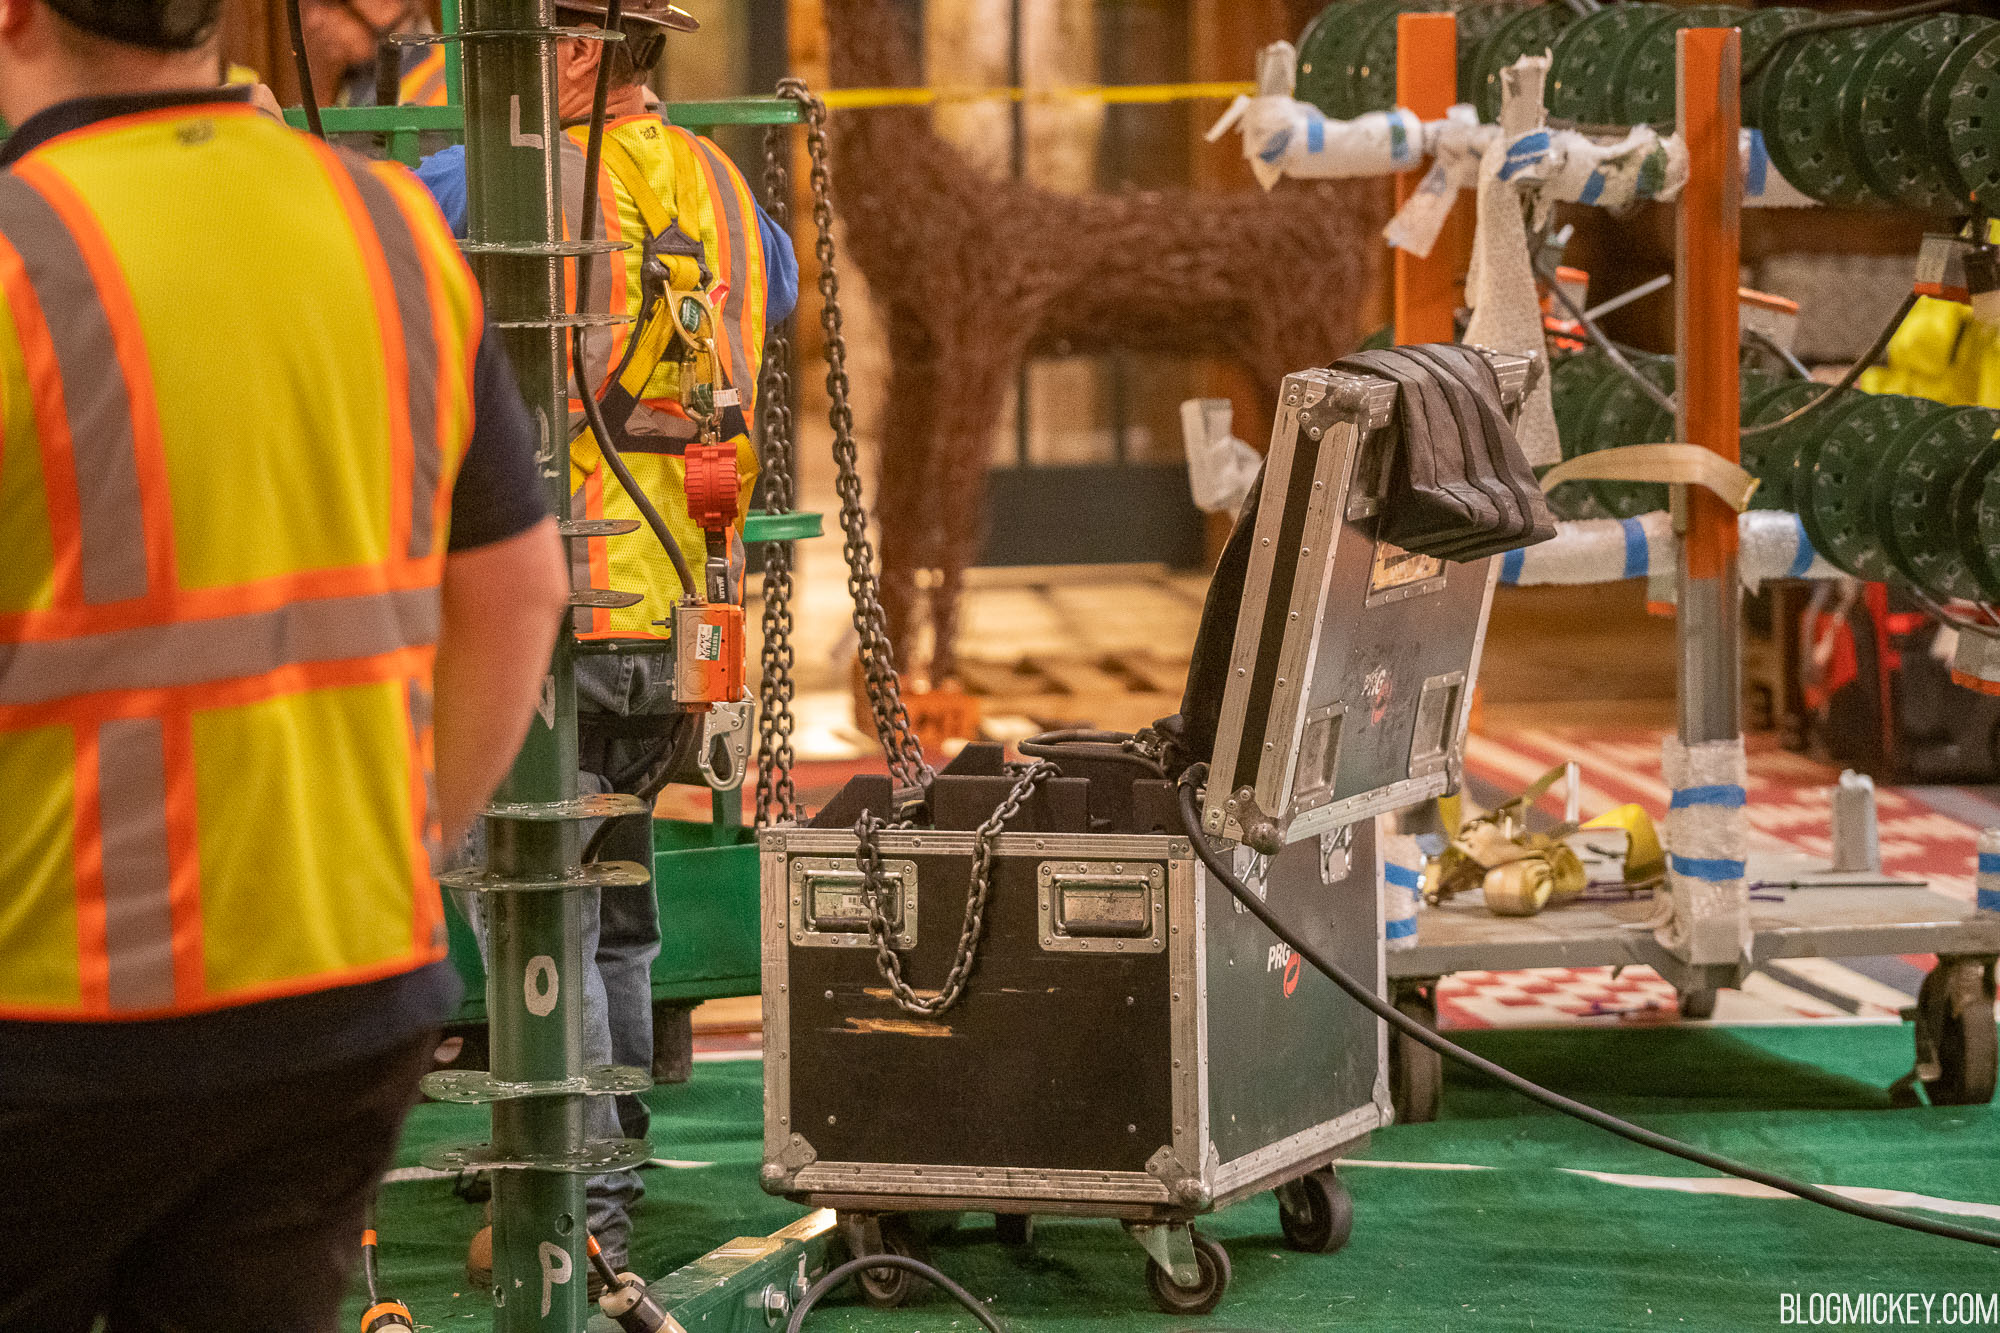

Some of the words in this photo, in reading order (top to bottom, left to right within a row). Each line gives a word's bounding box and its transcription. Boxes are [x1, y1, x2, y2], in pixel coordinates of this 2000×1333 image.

[510, 94, 544, 150] L
[716, 575, 726, 599] MILLER
[711, 632, 719, 656] TESTED
[1267, 942, 1291, 973] PRG
[538, 1241, 572, 1319] P
